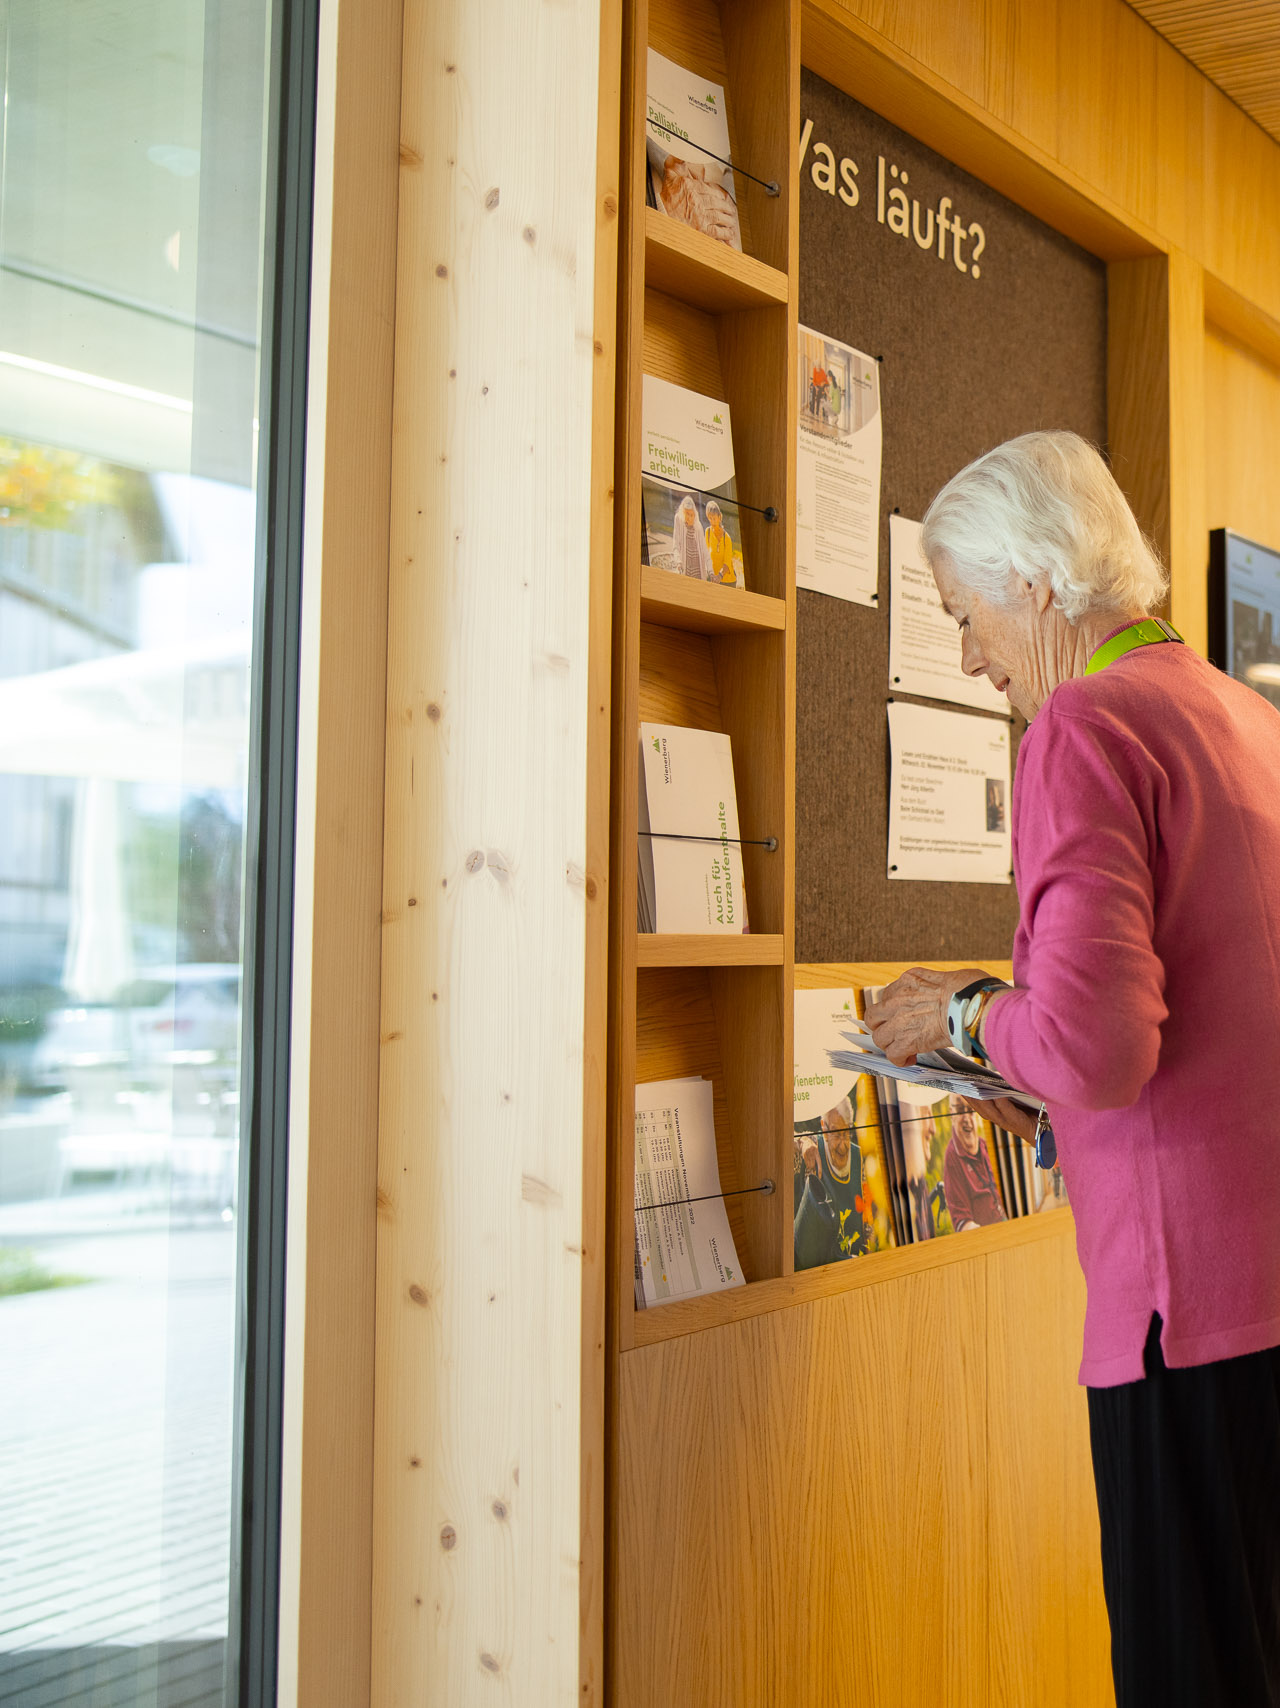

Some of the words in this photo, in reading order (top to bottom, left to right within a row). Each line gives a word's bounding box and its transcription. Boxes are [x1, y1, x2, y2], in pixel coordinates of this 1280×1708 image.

[687, 94, 718, 115] Wienerberg
[648, 106, 689, 141] Palliative
[650, 123, 671, 143] Care
[877, 156, 986, 279] läuft?
[695, 419, 724, 435] Wienerberg
[648, 443, 709, 472] Freiwilligen-
[650, 460, 681, 478] arbeit
[662, 738, 670, 785] Wienerberg
[712, 859, 720, 880] für
[718, 801, 734, 924] Kurzaufenthalte
[714, 885, 724, 924] Auch
[794, 1073, 833, 1087] ienerberg
[794, 1091, 810, 1102] ause
[674, 1107, 685, 1167] Veranstaltungen
[711, 1237, 726, 1283] Wienerberg
